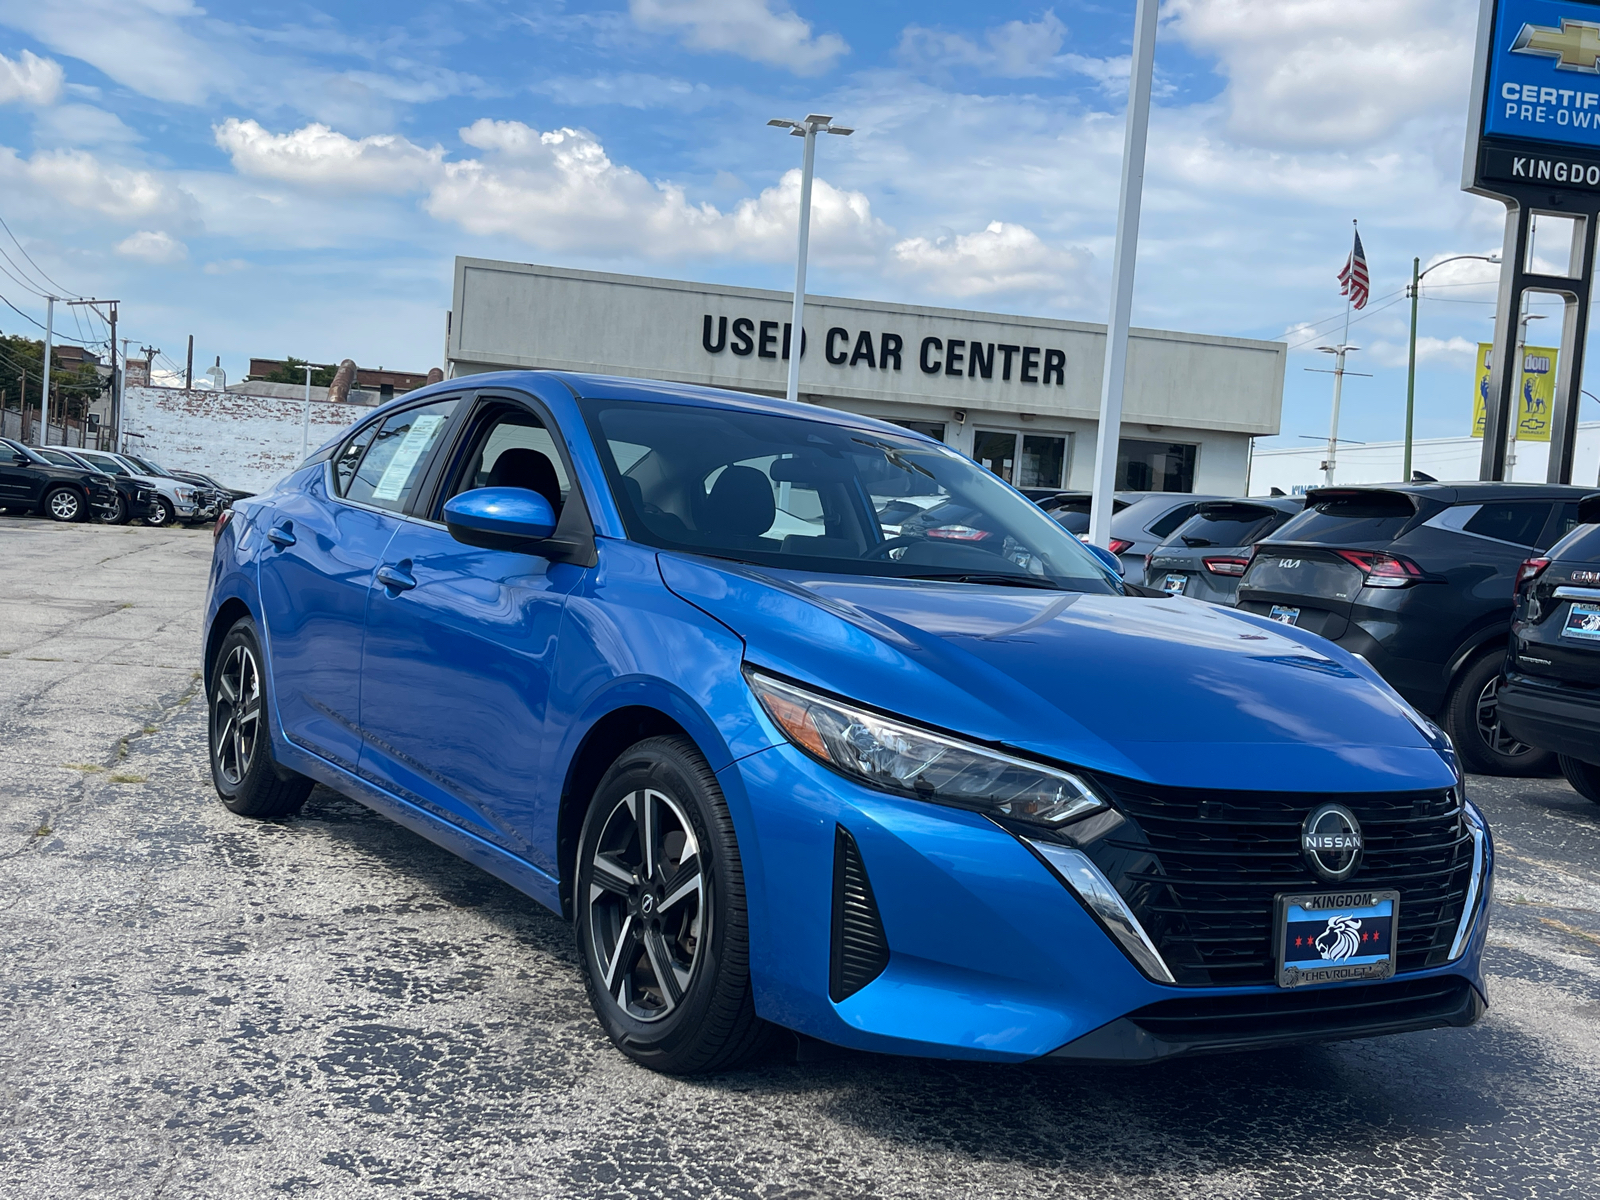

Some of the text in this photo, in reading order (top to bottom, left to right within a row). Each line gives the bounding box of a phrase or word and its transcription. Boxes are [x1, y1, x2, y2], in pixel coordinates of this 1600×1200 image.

[1501, 82, 1599, 109] CERTIF
[1512, 157, 1600, 185] KINGDO
[702, 314, 1066, 386] USED CAR CENTER
[1305, 835, 1361, 849] NISSAN
[1312, 893, 1373, 909] KINGDOM
[1305, 966, 1367, 982] CHEVROLET
